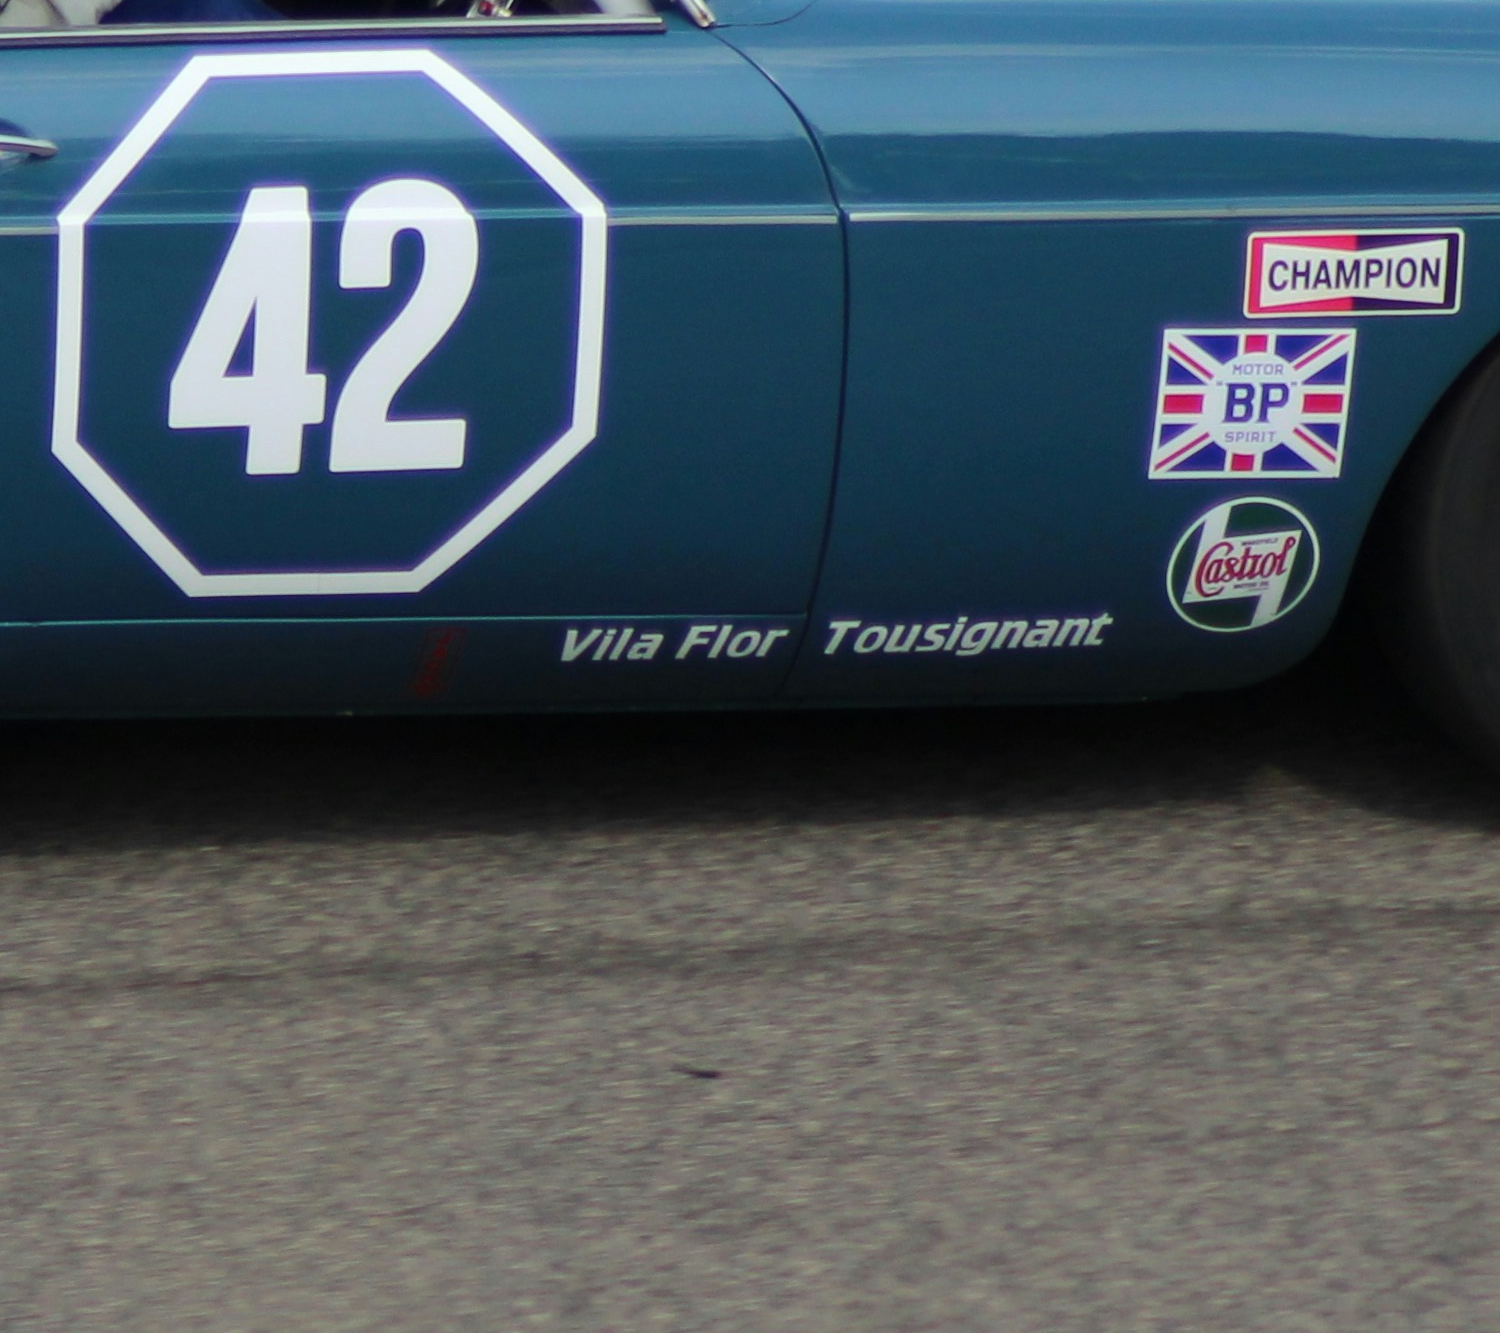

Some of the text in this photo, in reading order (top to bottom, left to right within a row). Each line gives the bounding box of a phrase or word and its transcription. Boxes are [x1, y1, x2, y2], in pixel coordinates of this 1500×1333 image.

[1267, 256, 1442, 292] CHAMPION
[168, 178, 480, 475] 42
[1233, 363, 1284, 375] MOTOR
[1224, 431, 1277, 443] SPIRIT
[1194, 536, 1297, 599] Castrol
[559, 612, 1114, 662] Vila Flor Tousignant
